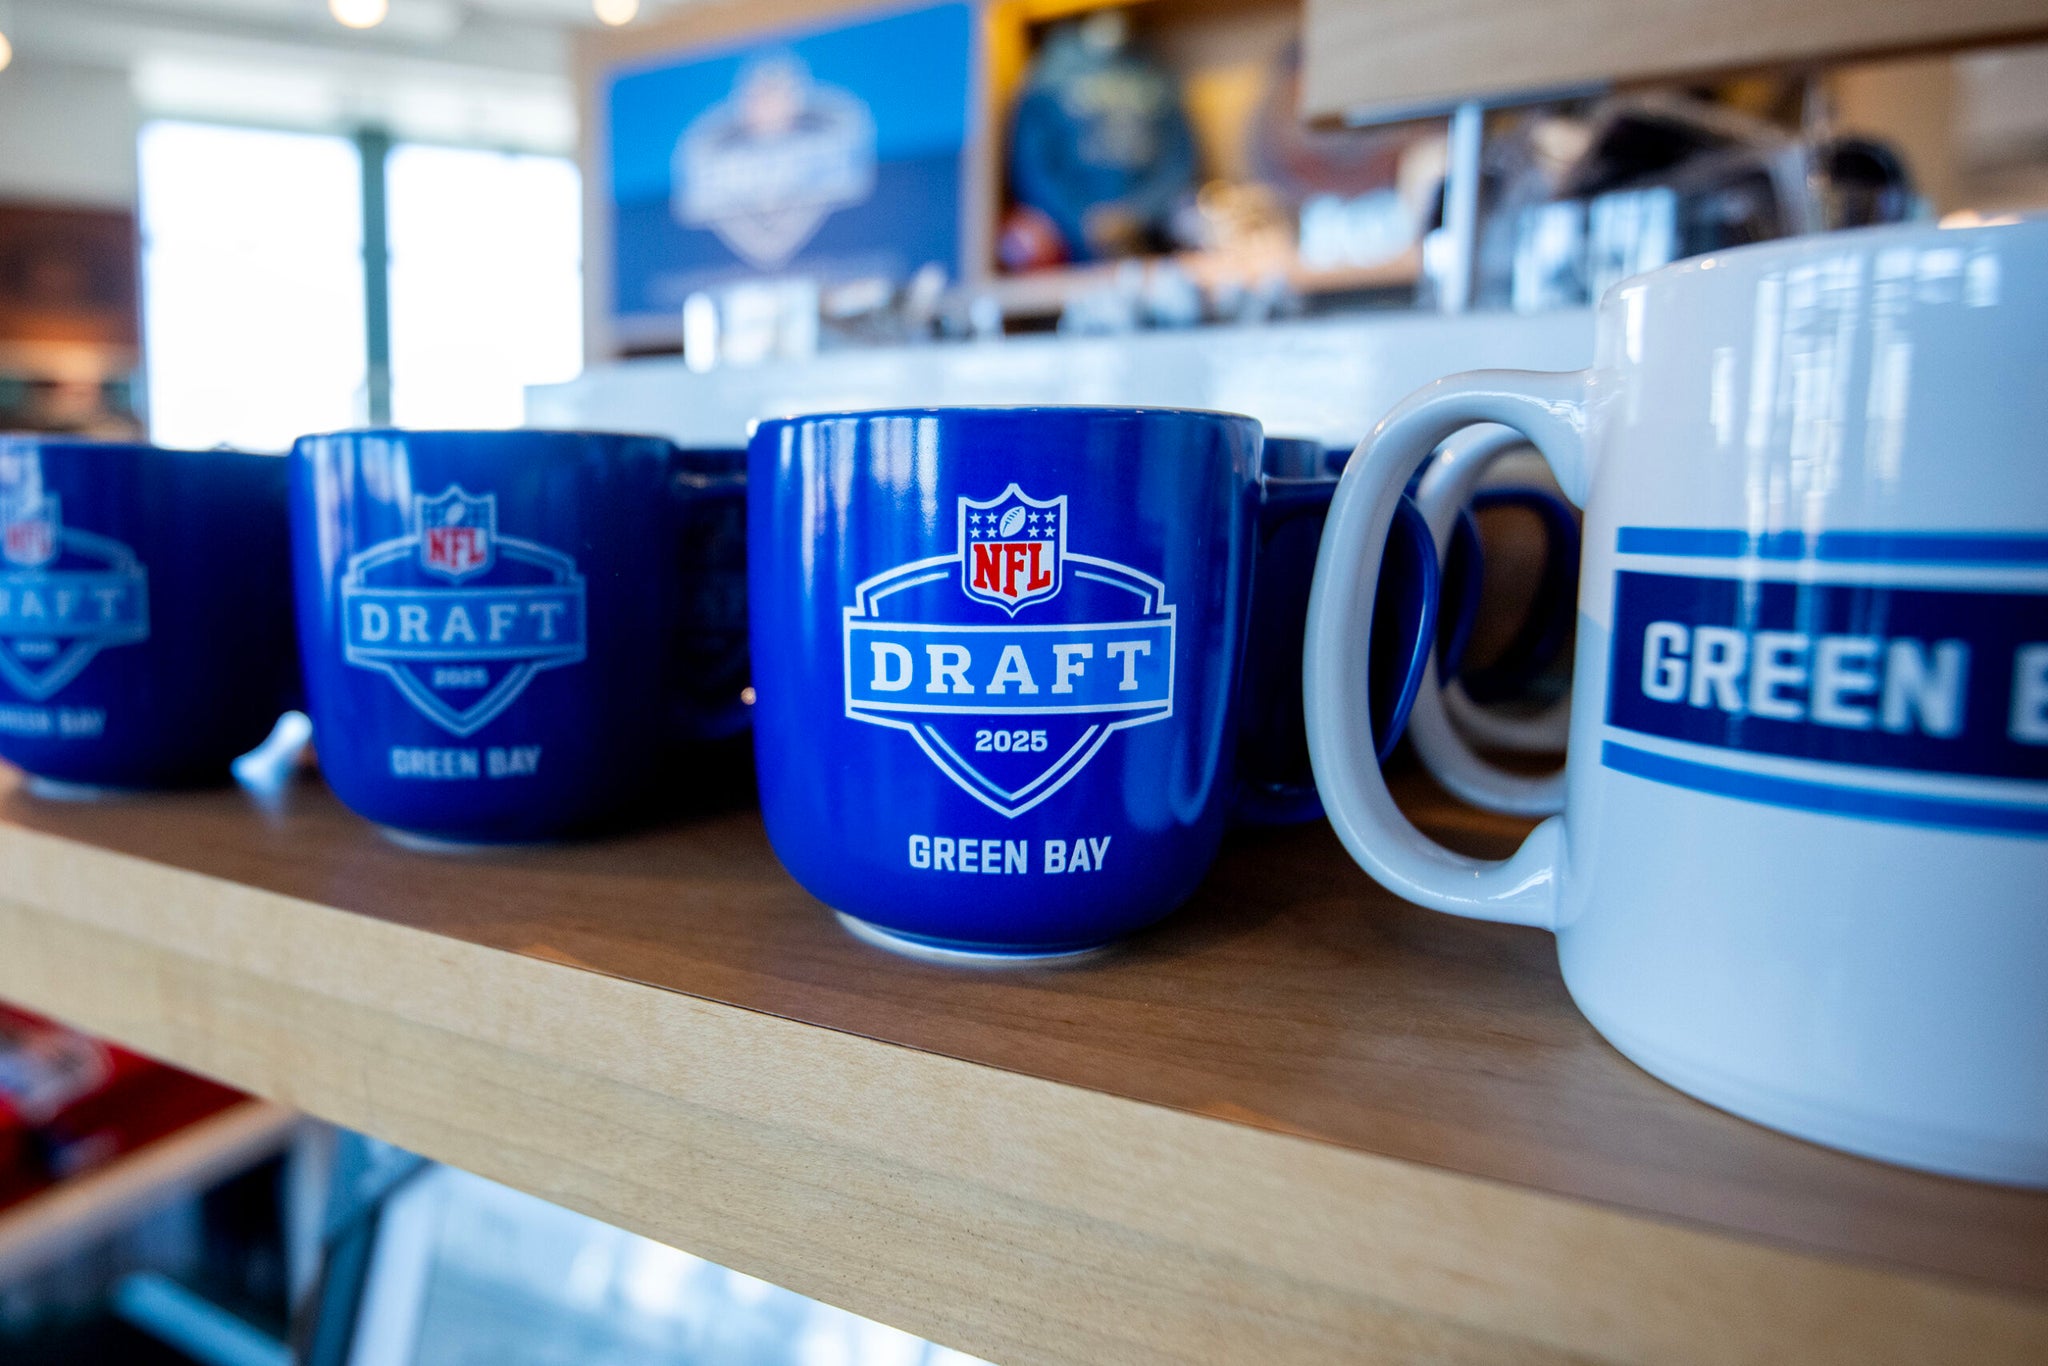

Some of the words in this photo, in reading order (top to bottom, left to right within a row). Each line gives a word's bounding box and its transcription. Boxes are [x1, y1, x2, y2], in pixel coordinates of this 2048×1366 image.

[427, 527, 487, 568] NFL
[973, 543, 1051, 598] NFL
[359, 603, 564, 643] DRAFT
[870, 641, 1151, 694] DRAFT
[1641, 621, 1970, 738] GREEN
[975, 729, 1048, 752] 2025
[391, 746, 478, 778] GREEN
[487, 746, 541, 778] BAY
[908, 834, 1028, 874] GREEN
[1043, 836, 1111, 874] BAY
